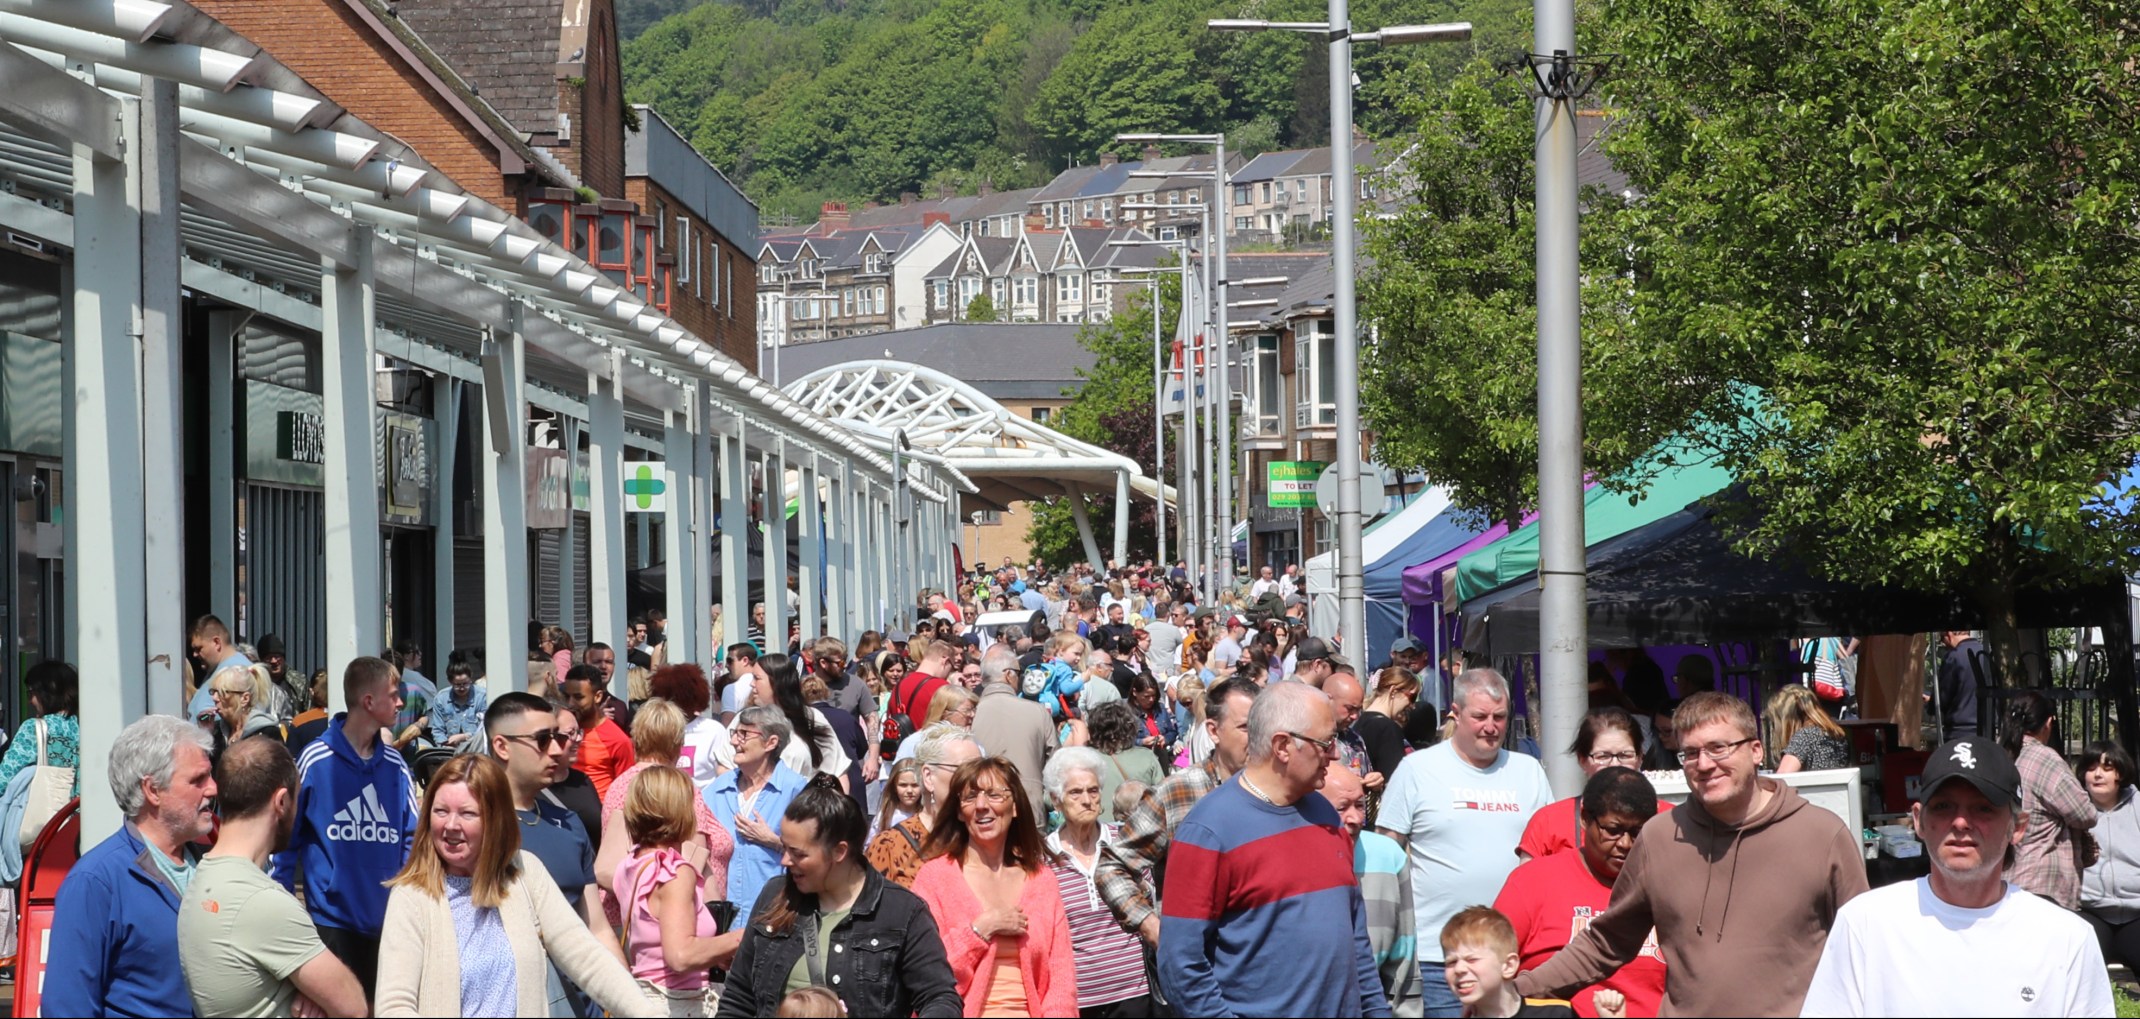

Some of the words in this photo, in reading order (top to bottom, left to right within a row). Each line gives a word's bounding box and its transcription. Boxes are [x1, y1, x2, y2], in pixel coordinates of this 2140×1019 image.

[1272, 464, 1312, 479] ejhales
[1450, 787, 1517, 802] TOMMY
[1480, 802, 1520, 812] JEANS
[326, 820, 400, 844] adidas
